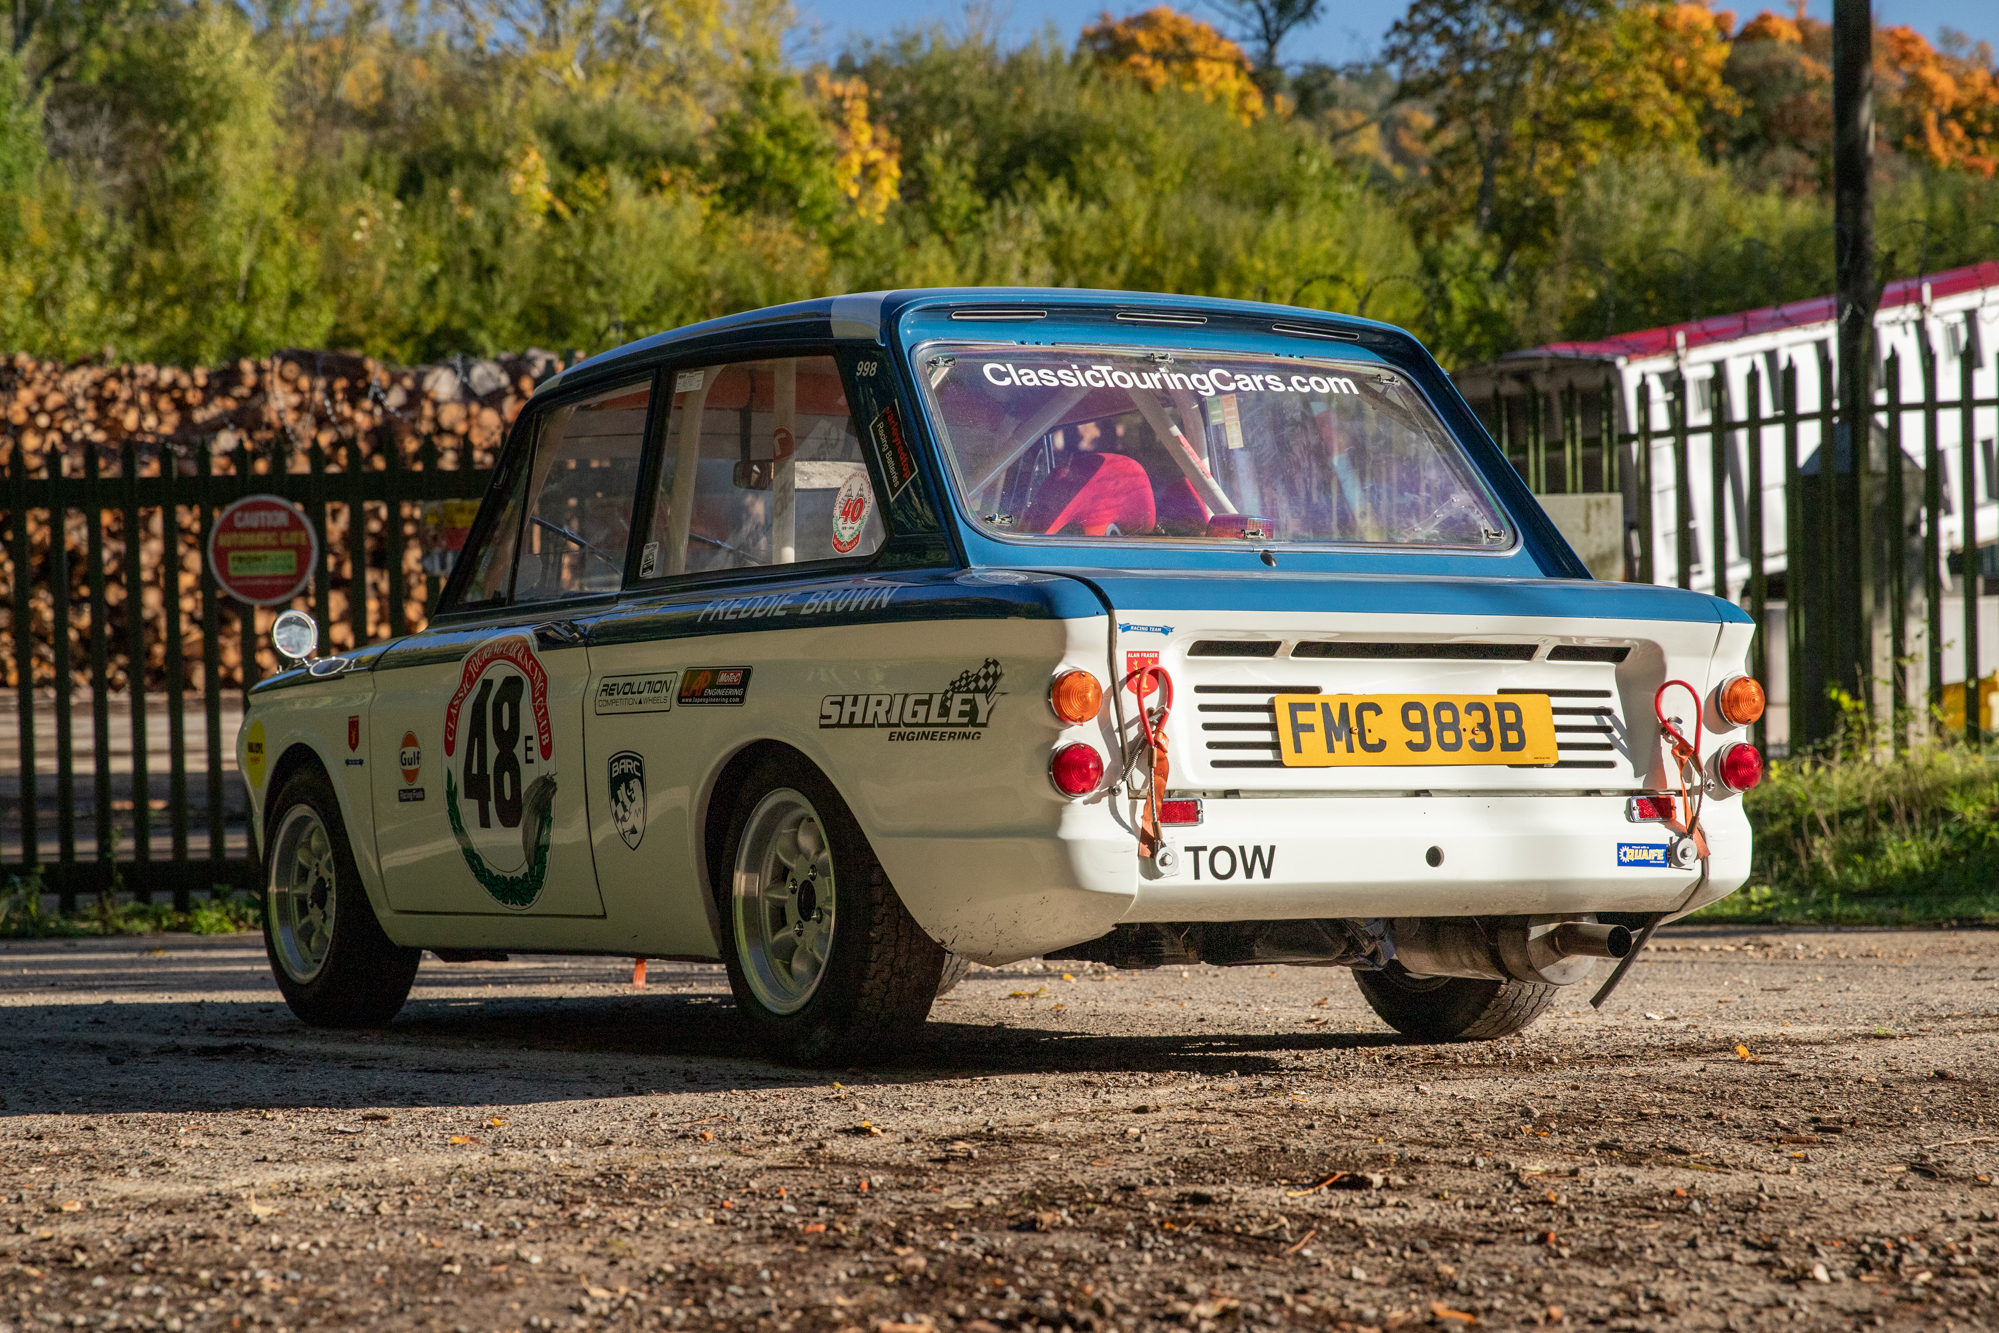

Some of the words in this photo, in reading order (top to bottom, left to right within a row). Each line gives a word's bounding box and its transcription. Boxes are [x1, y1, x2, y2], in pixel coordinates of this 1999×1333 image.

[856, 361, 877, 376] 998
[982, 362, 1360, 397] ClassicTouringCars.com
[877, 421, 889, 452] Racing
[885, 450, 900, 488] Batteries
[840, 497, 864, 523] 40
[697, 593, 800, 623] FREDDIE
[800, 584, 901, 615] BROWN
[600, 680, 672, 696] REVOLUTION
[718, 672, 741, 683] MoTeC
[446, 673, 472, 741] CLASSIC
[517, 646, 545, 698] RACING
[535, 697, 550, 746] CLUB
[598, 698, 638, 708] COMPETITION
[643, 696, 668, 704] WHEELS
[703, 688, 744, 696] ENGINEERING
[819, 693, 1009, 729] SHRIGLEY
[888, 730, 982, 742] ENGINEERING
[1287, 701, 1388, 754] FMC
[1400, 701, 1528, 754] 983B
[400, 751, 420, 766] Gulf
[463, 675, 523, 829] 48
[524, 735, 535, 764] E
[612, 759, 641, 777] BARC
[1184, 844, 1276, 881] TOW
[1626, 849, 1664, 861] QUAIFE
